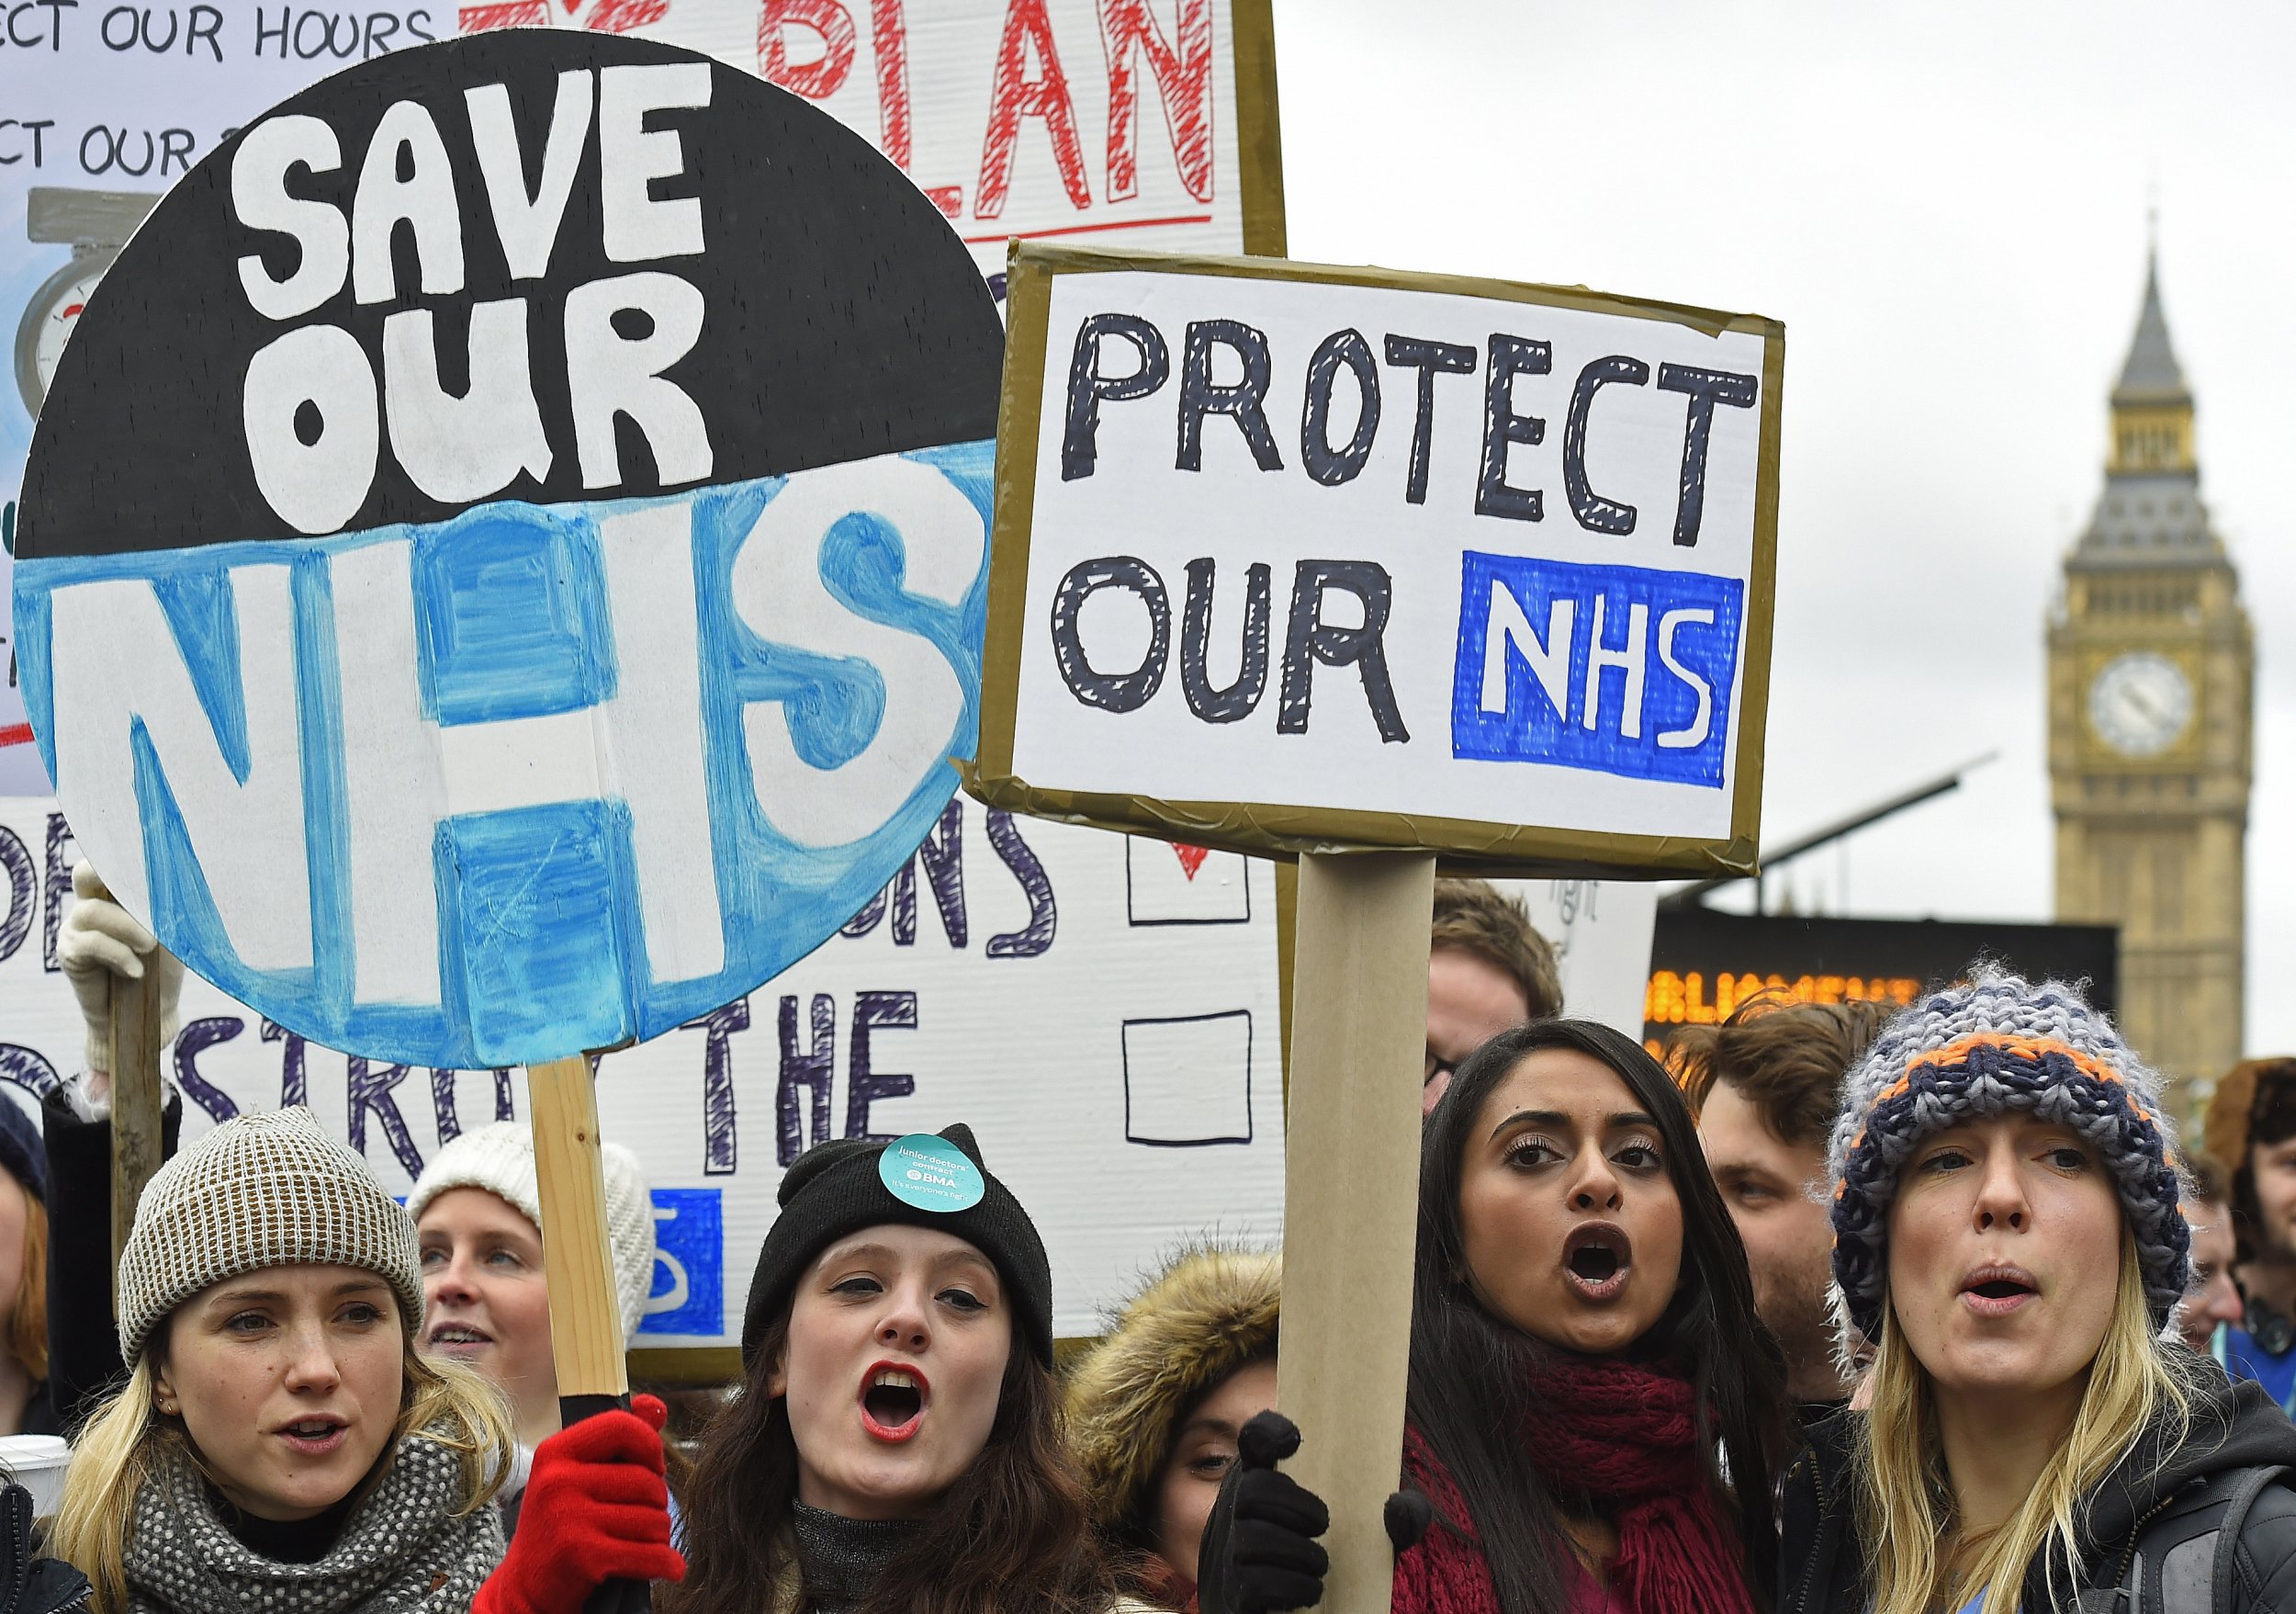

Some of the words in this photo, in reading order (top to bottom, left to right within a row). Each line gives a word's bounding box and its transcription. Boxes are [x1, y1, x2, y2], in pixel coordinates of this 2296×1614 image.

[0, 0, 78, 51] CT
[101, 5, 223, 62] OUR
[255, 6, 435, 59] HOURS
[757, 0, 1214, 219] PLAN
[80, 125, 196, 176] OUR
[231, 62, 713, 321] SAVE
[243, 271, 714, 535] OUR
[1061, 312, 1758, 547] PROTECT
[51, 454, 985, 1010] NHS
[1051, 555, 1411, 743] OUR
[1477, 578, 1717, 750] NHS
[679, 991, 917, 1176] THE
[912, 1161, 953, 1176] contract
[905, 1182, 949, 1198] everyone's
[922, 1173, 956, 1188] BMA
